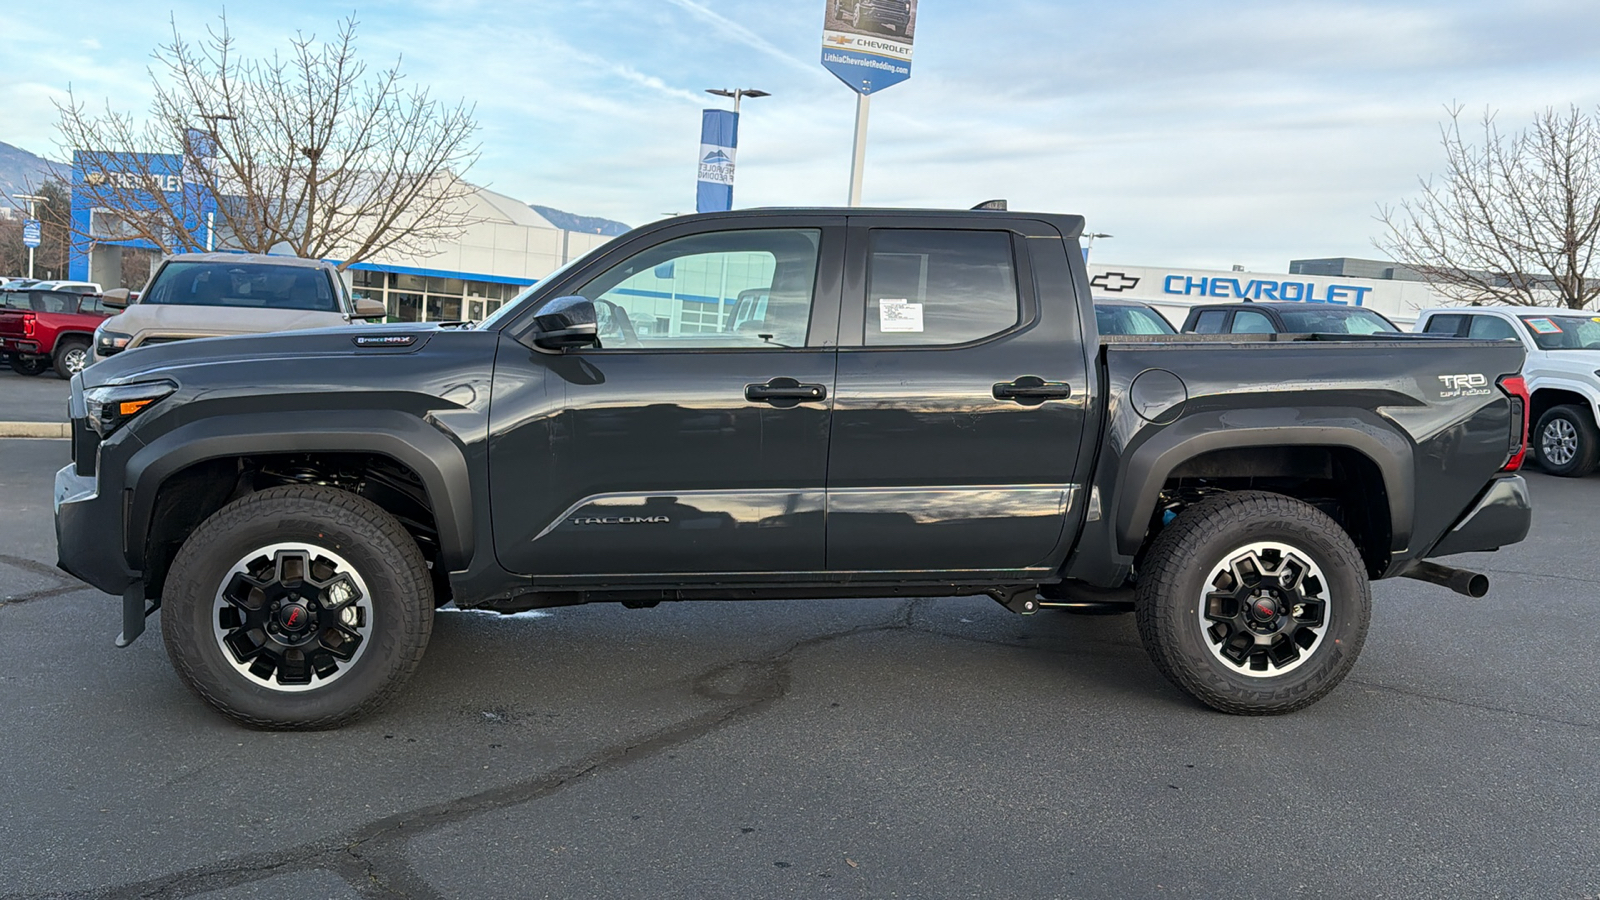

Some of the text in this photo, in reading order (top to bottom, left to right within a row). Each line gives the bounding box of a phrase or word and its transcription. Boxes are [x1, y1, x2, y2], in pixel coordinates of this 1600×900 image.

[856, 38, 909, 55] CHEVROLET
[824, 53, 909, 75] LithiaChevroletRedding.com
[1164, 275, 1373, 307] CHEVROLET
[1438, 373, 1487, 389] TRD
[568, 515, 670, 525] TACOMA
